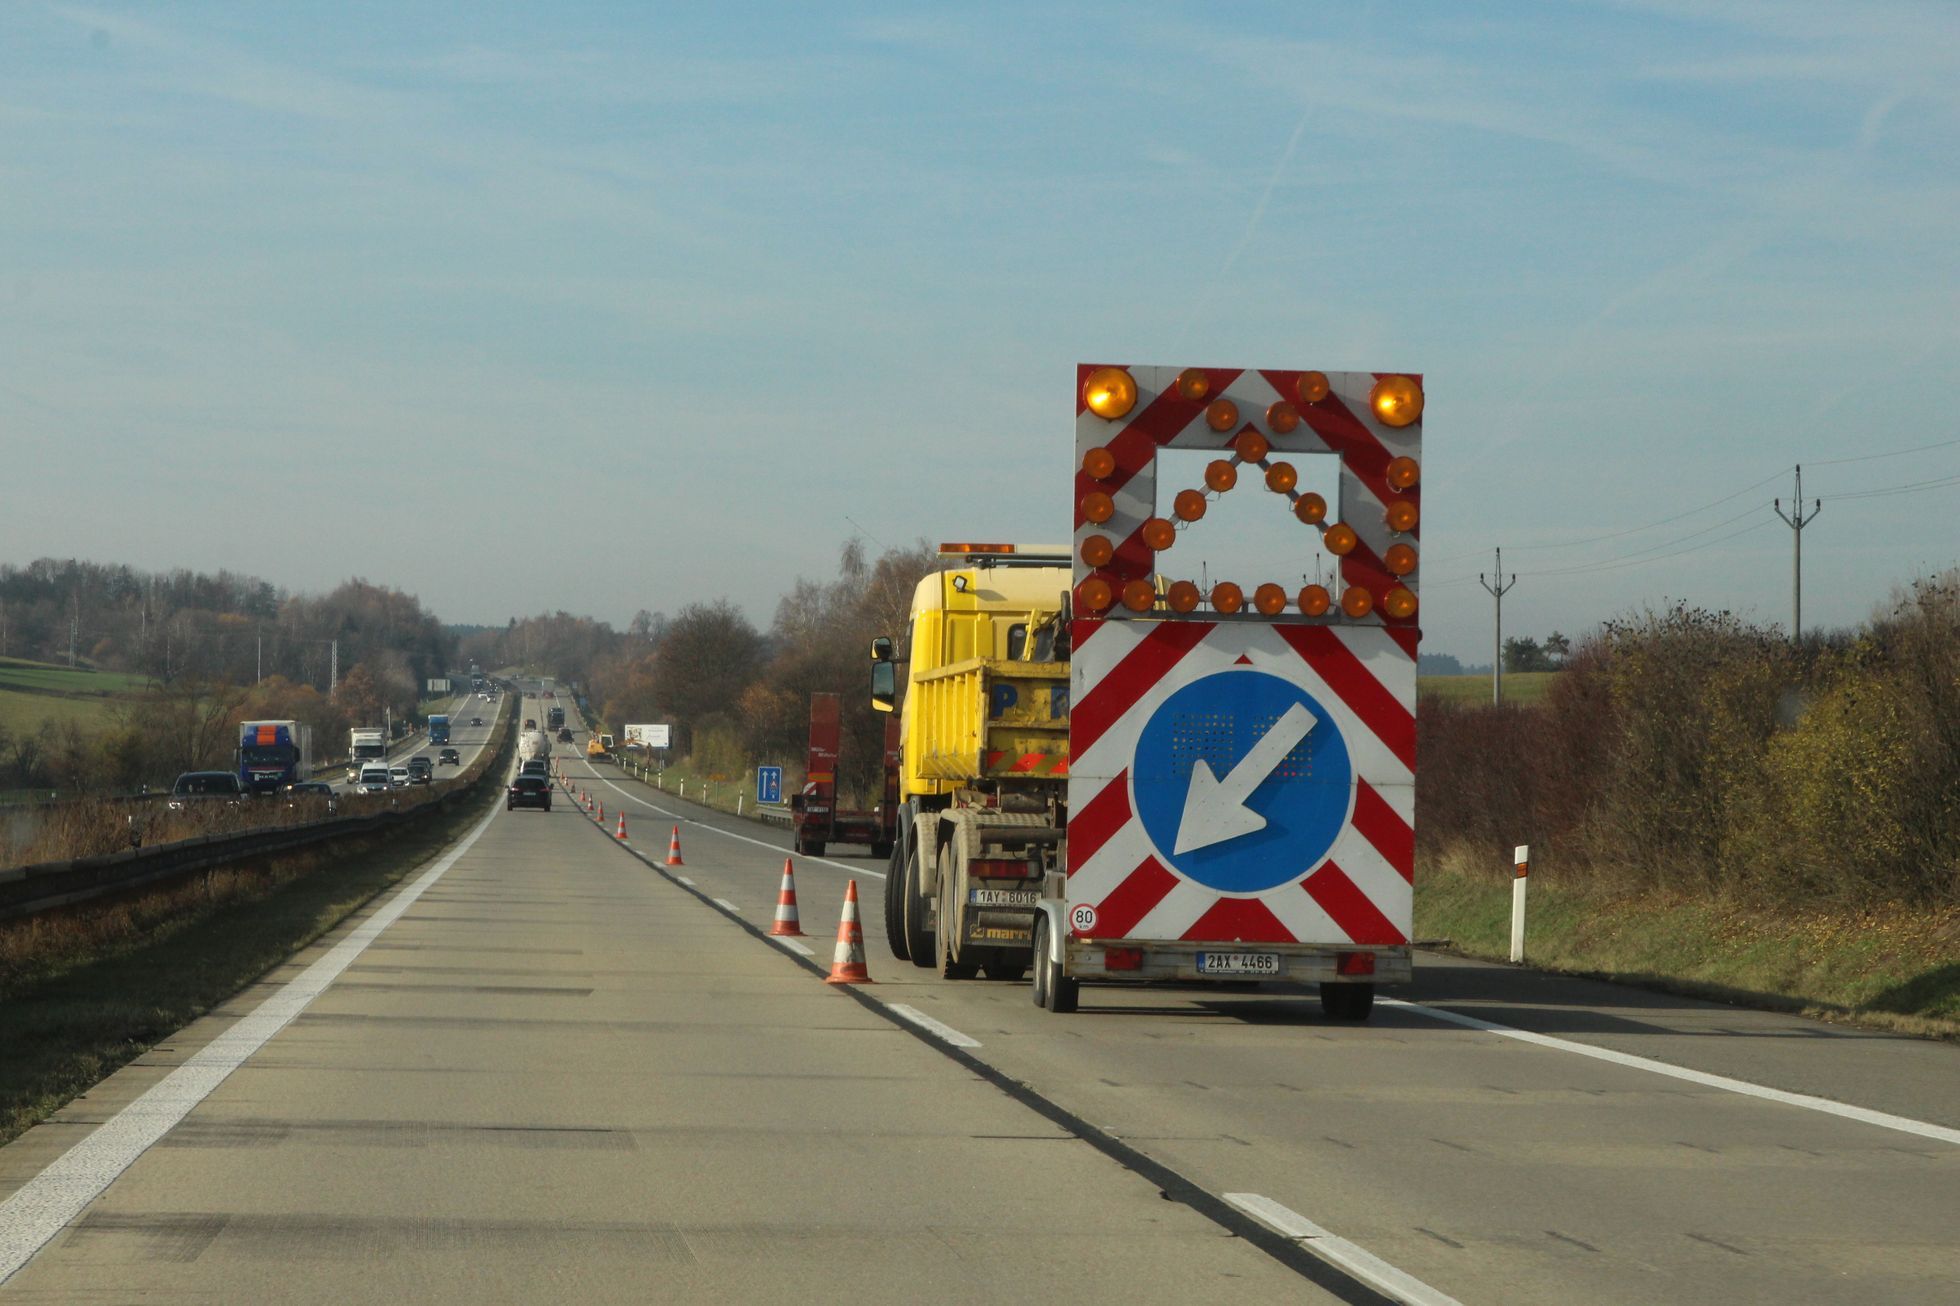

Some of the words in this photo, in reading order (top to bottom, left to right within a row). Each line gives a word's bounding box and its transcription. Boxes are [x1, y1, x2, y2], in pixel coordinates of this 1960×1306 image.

[981, 891, 1000, 903] 1AY
[1076, 910, 1093, 924] 80
[1208, 955, 1231, 969] 2AX
[1241, 955, 1272, 969] 4466
